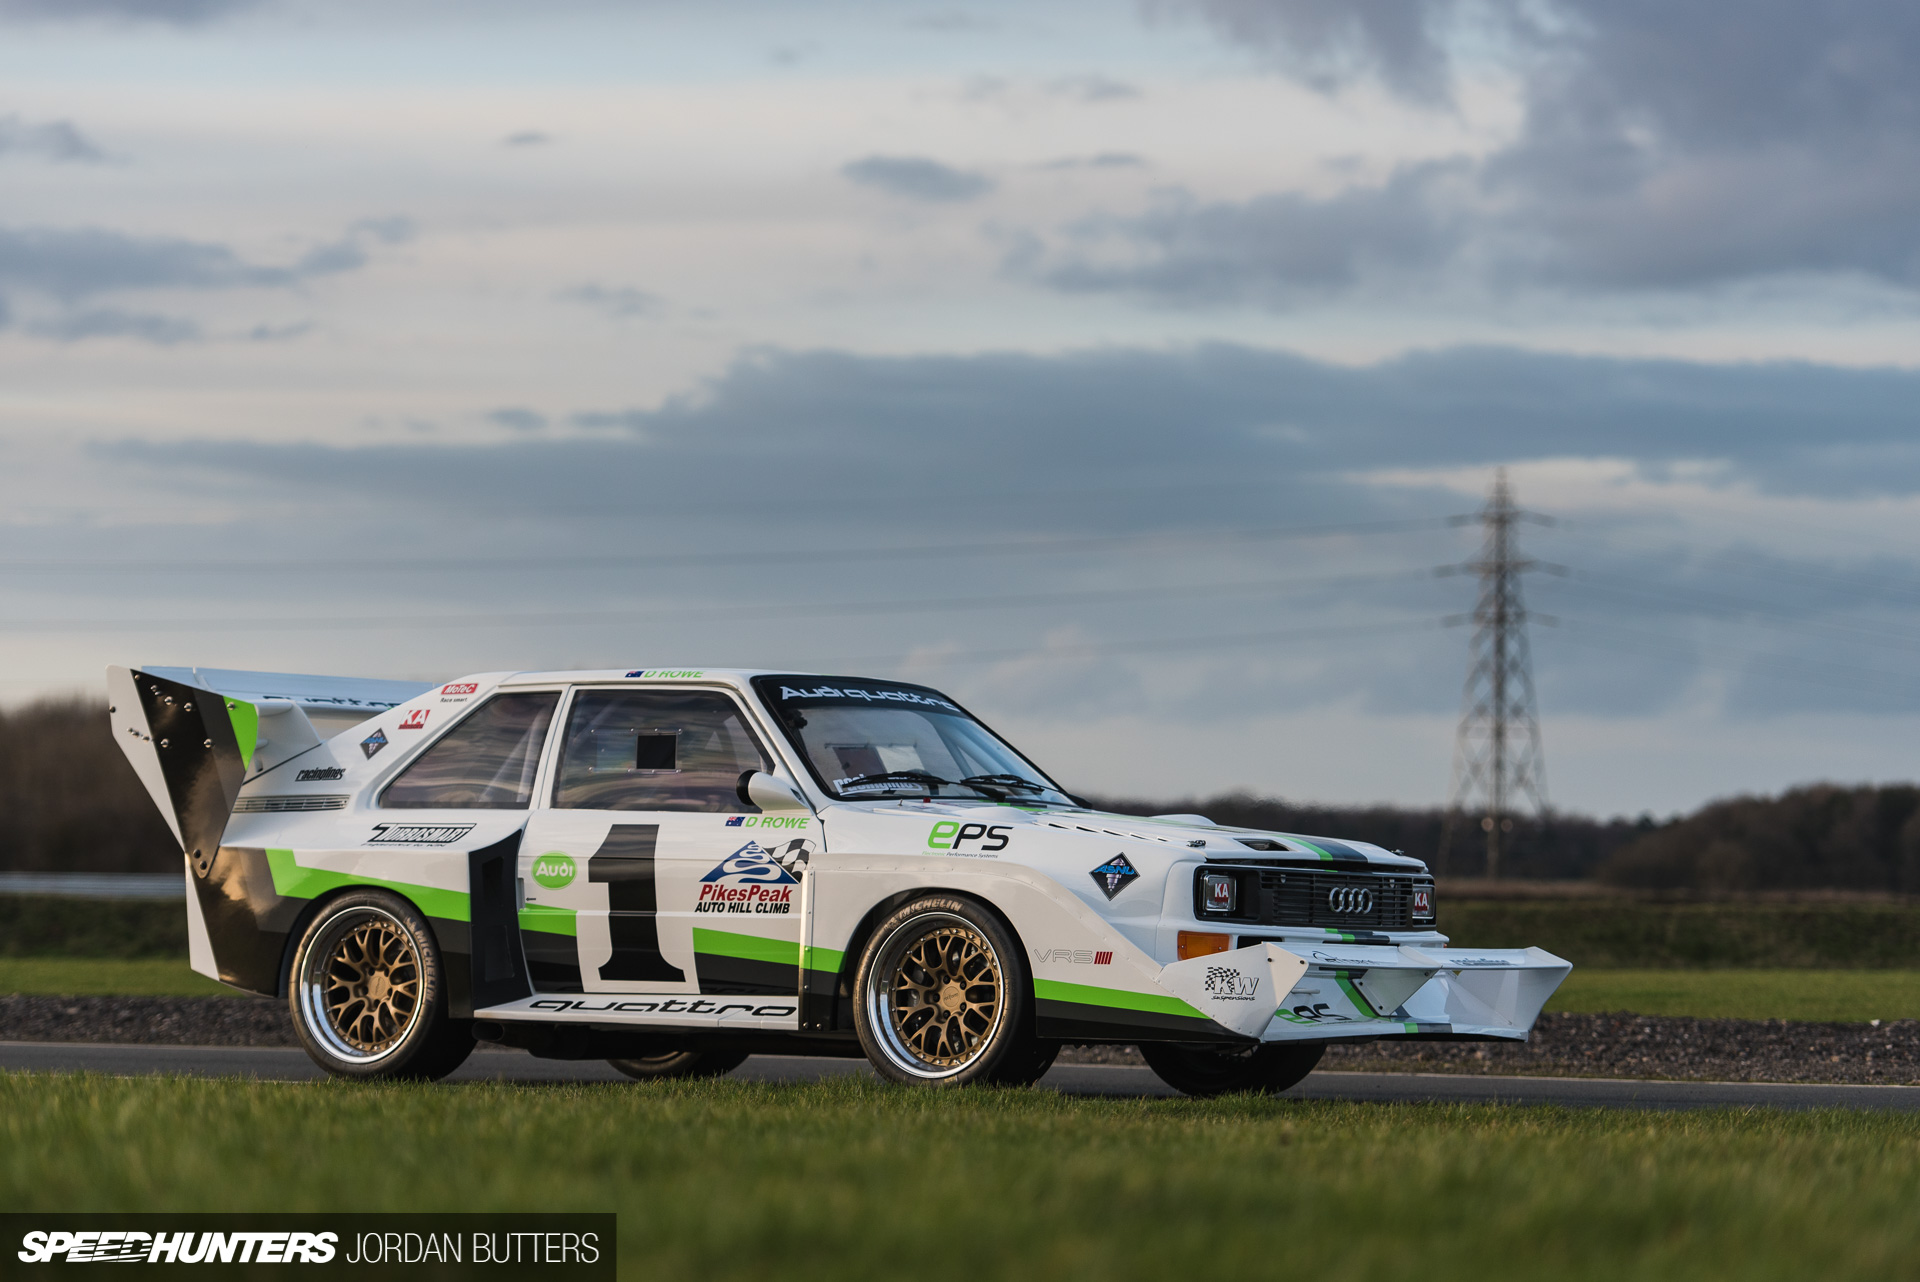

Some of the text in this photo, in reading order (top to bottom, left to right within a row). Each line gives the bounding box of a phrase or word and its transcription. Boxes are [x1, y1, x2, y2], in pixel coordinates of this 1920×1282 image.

[644, 670, 706, 678] D ROWE
[780, 686, 960, 712] Audi quattro
[400, 709, 426, 725] KA
[745, 816, 810, 829] D ROWE
[367, 822, 477, 844] TURBOSMART
[535, 861, 574, 877] Audi
[1094, 864, 1136, 875] ASNU
[1215, 883, 1229, 898] KA
[588, 824, 686, 982] 1
[1415, 892, 1428, 907] KA
[695, 902, 790, 914] AUTO HILL CLIMB
[900, 898, 963, 919] MICHELIN
[1034, 949, 1093, 964] VRS
[1213, 976, 1259, 995] KW
[529, 999, 797, 1017] quattro
